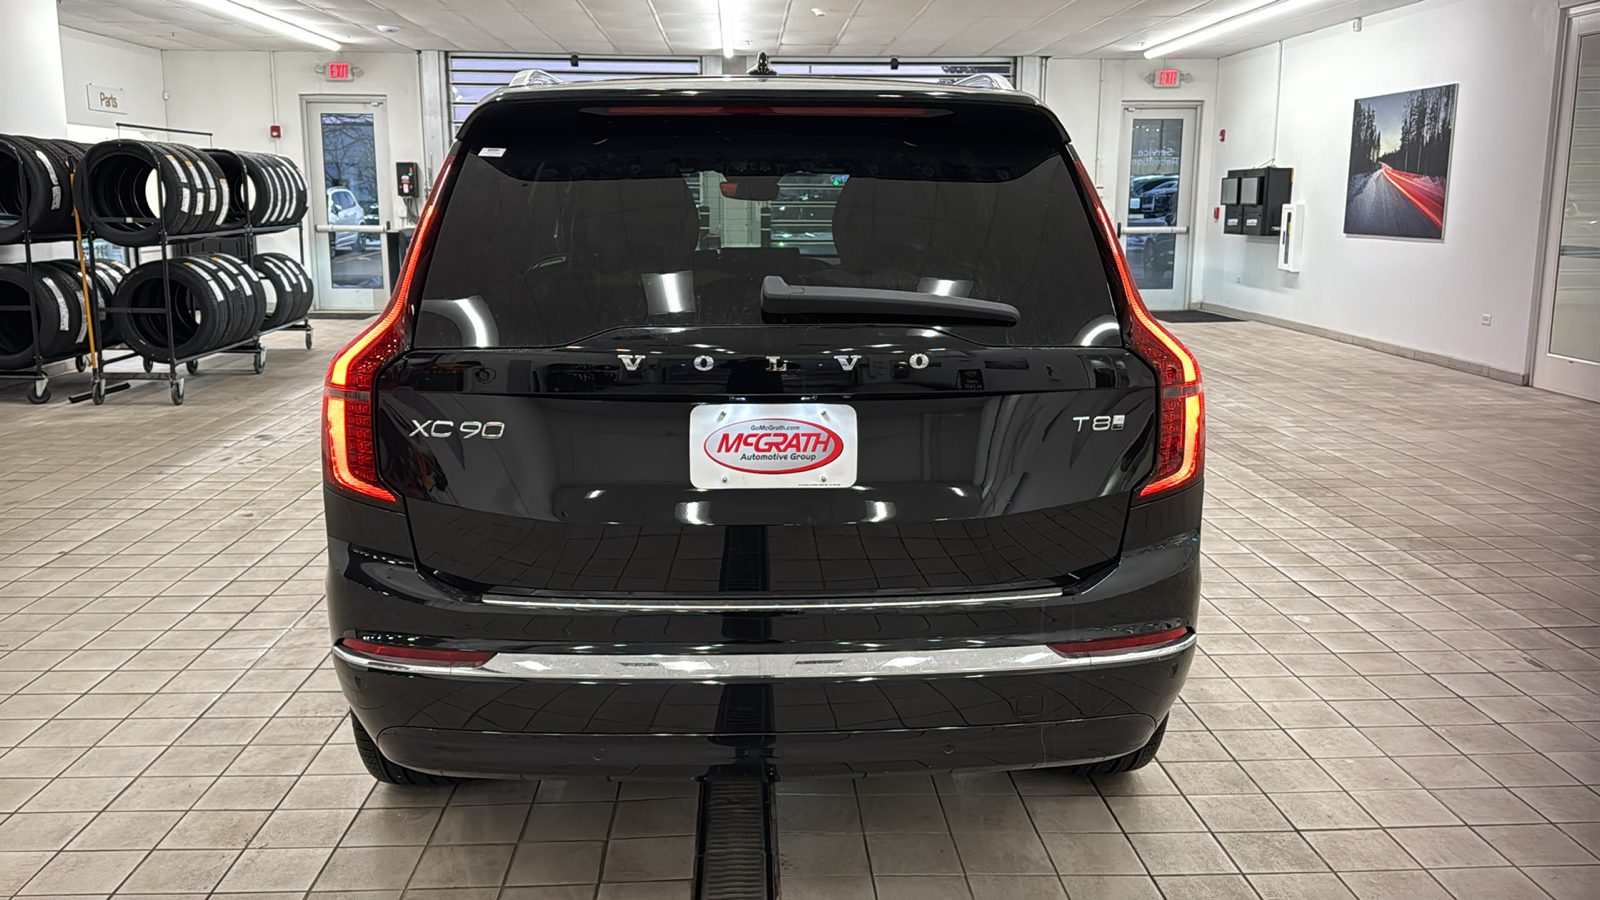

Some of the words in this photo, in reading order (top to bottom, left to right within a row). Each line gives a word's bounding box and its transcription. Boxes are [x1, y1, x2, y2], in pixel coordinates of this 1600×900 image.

[329, 62, 348, 78] EXIT
[1159, 70, 1178, 85] EXIT
[100, 91, 118, 108] Parts
[617, 354, 930, 372] VOLVO
[1072, 415, 1111, 432] T8
[740, 453, 788, 461] Automotive
[791, 453, 816, 462] Group
